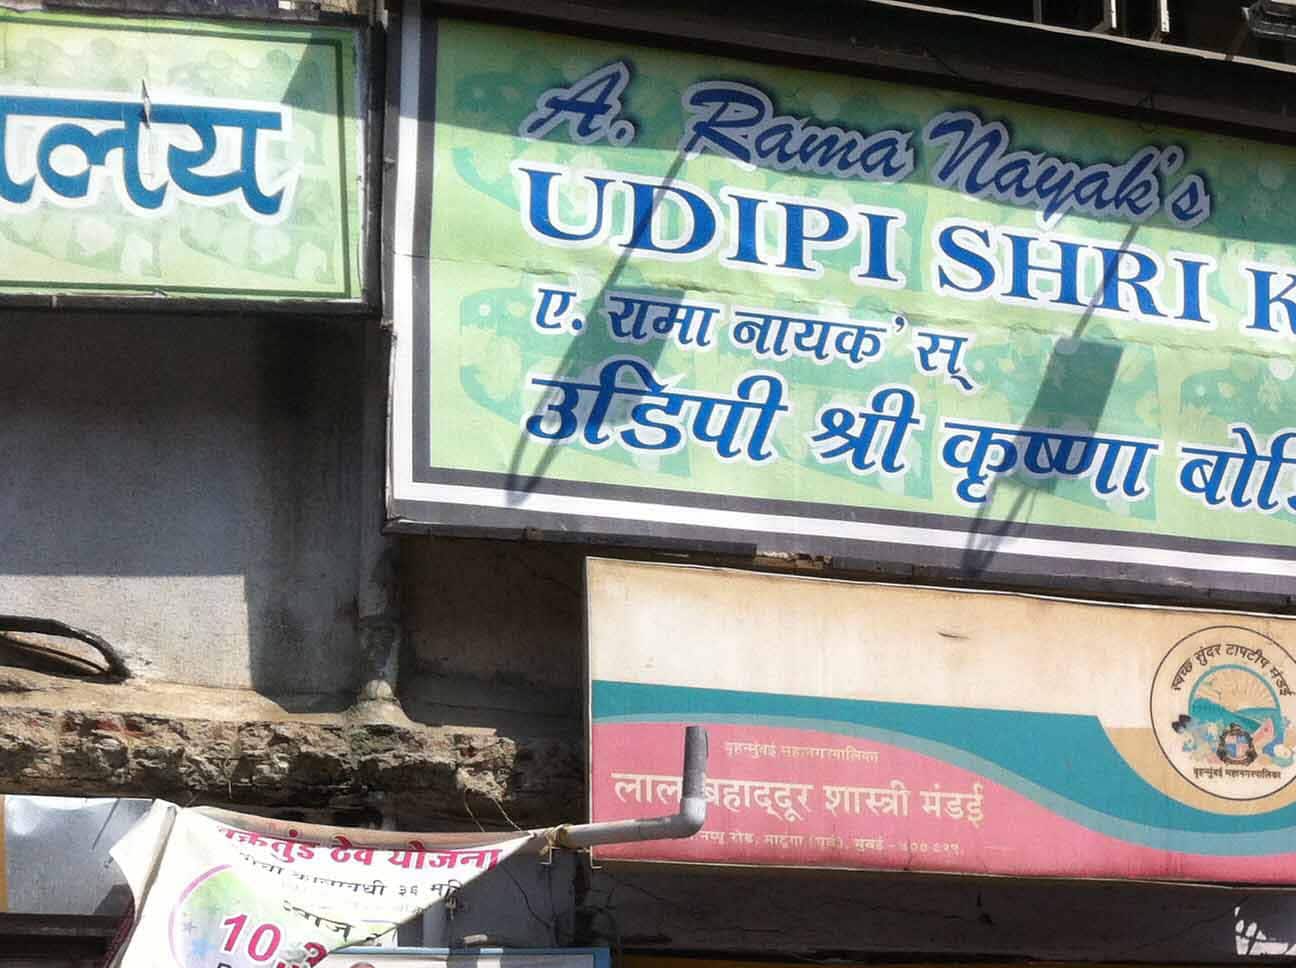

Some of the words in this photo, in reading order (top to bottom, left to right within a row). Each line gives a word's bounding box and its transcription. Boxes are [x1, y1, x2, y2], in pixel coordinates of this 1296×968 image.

[529, 62, 631, 142] A.
[687, 86, 910, 180] Rama
[928, 115, 1205, 222] Nayak's
[518, 167, 899, 283] UDIPI
[937, 222, 1211, 325] SHRI
[536, 288, 583, 331] ए.
[608, 297, 720, 347] रामा
[526, 359, 788, 461] उडिपी
[811, 387, 920, 473] श्री
[941, 421, 1159, 504] कृष्णा
[1194, 643, 1222, 666] सुंदर
[610, 771, 684, 806] लाल
[823, 778, 912, 818] शास्त्री
[919, 782, 985, 824] मंडई
